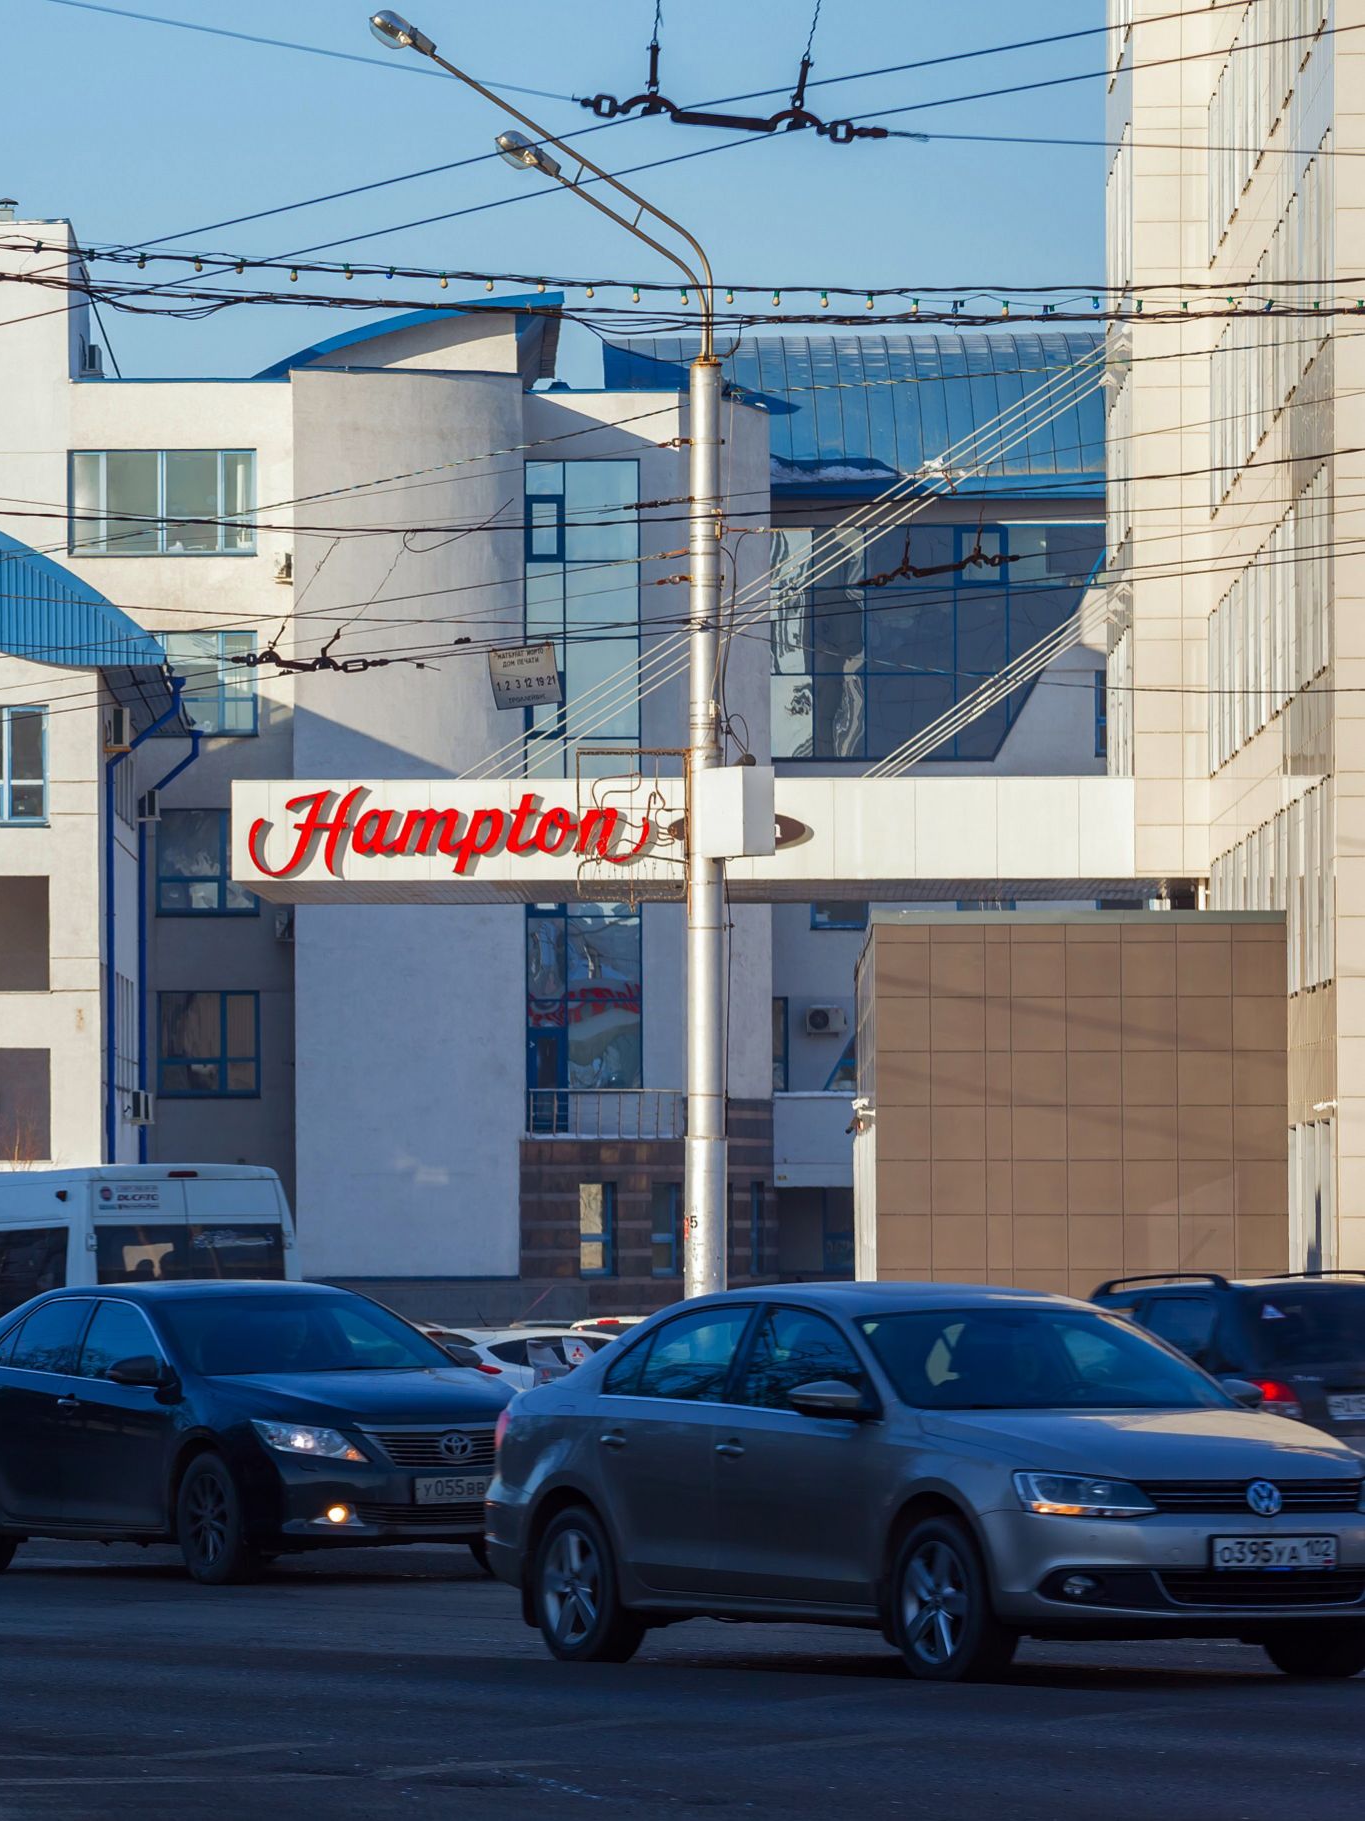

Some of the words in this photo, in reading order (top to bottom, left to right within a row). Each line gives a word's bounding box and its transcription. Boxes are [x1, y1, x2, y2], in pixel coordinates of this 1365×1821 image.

[497, 682, 501, 692] 1
[505, 681, 510, 690] 2
[515, 679, 521, 689] 3
[524, 677, 533, 688] 12
[536, 677, 544, 687] 19
[547, 675, 555, 685] 21
[249, 785, 650, 876] Hampton
[689, 1215, 698, 1229] 5
